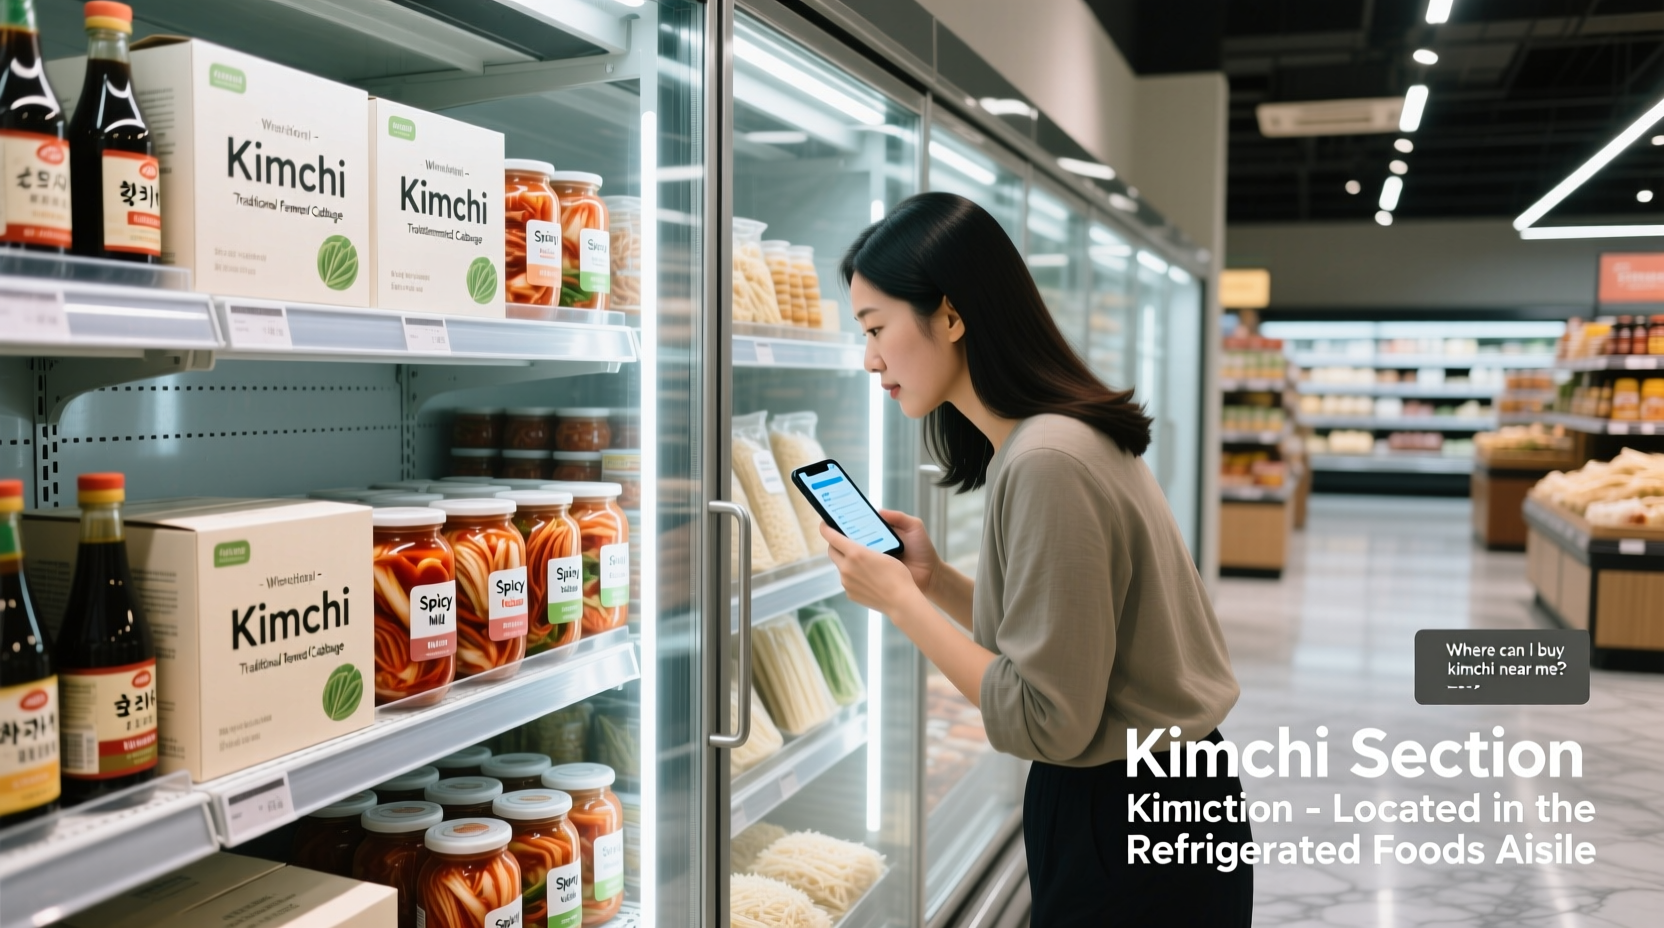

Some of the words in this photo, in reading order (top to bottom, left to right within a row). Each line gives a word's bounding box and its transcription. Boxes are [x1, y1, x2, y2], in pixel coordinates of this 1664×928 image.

[228, 136, 345, 199] Kimchi
[401, 175, 487, 225] Kimchi
[419, 594, 453, 612] Spicy
[496, 579, 525, 597] Spicy
[232, 586, 350, 651] Kimchi
